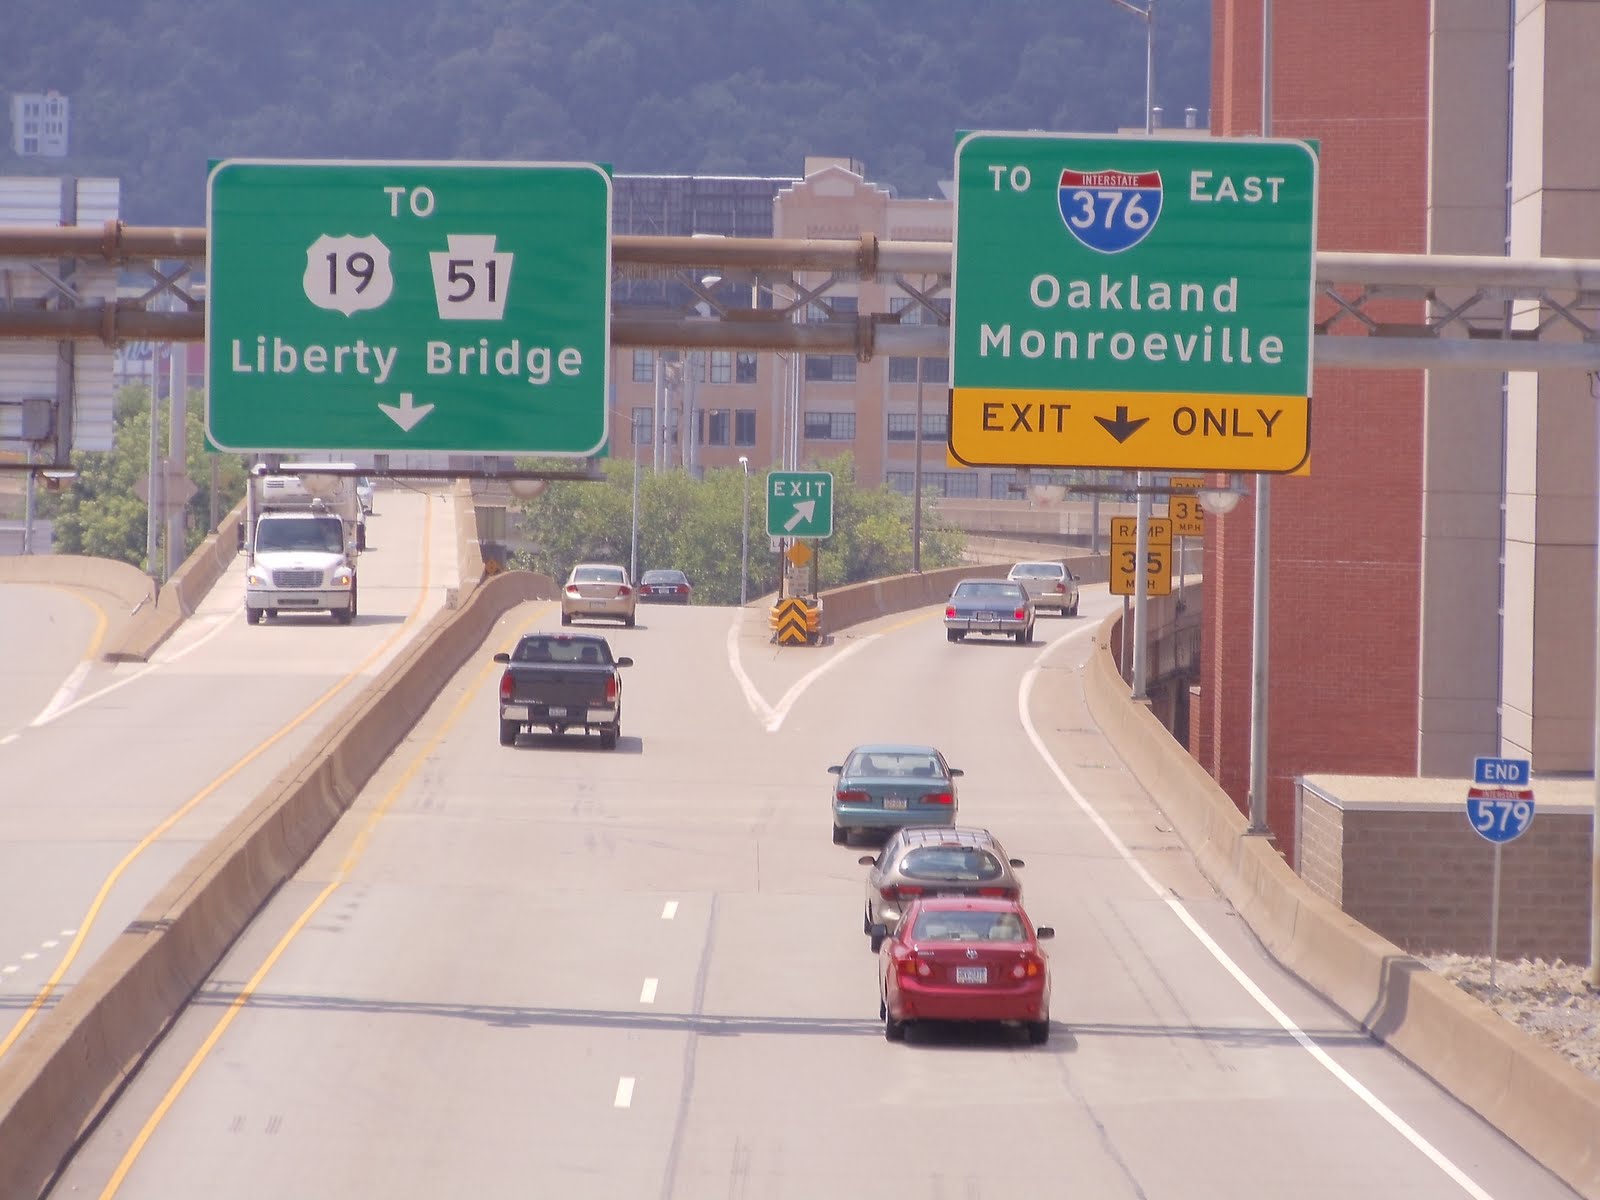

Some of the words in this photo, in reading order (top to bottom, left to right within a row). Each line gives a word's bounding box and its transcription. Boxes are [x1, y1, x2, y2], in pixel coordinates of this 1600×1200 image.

[989, 165, 1032, 193] TO
[1082, 175, 1140, 187] INTERSTATE
[1190, 170, 1285, 205] EAST
[383, 186, 436, 218] TO
[1071, 191, 1149, 230] 376
[325, 251, 376, 297] 19
[446, 259, 498, 304] 51
[1030, 273, 1239, 313] Oakland
[979, 323, 1284, 366] Monroeville
[231, 336, 398, 385] Liberty
[425, 338, 583, 386] Bridge
[982, 403, 1071, 433] EXIT
[1172, 407, 1282, 438] ONLY
[774, 481, 826, 497] EXIT
[1176, 503, 1204, 520] 35
[1121, 551, 1162, 574] 35
[1126, 579, 1155, 589] MH
[1484, 763, 1520, 781] END
[1478, 801, 1530, 832] 579
